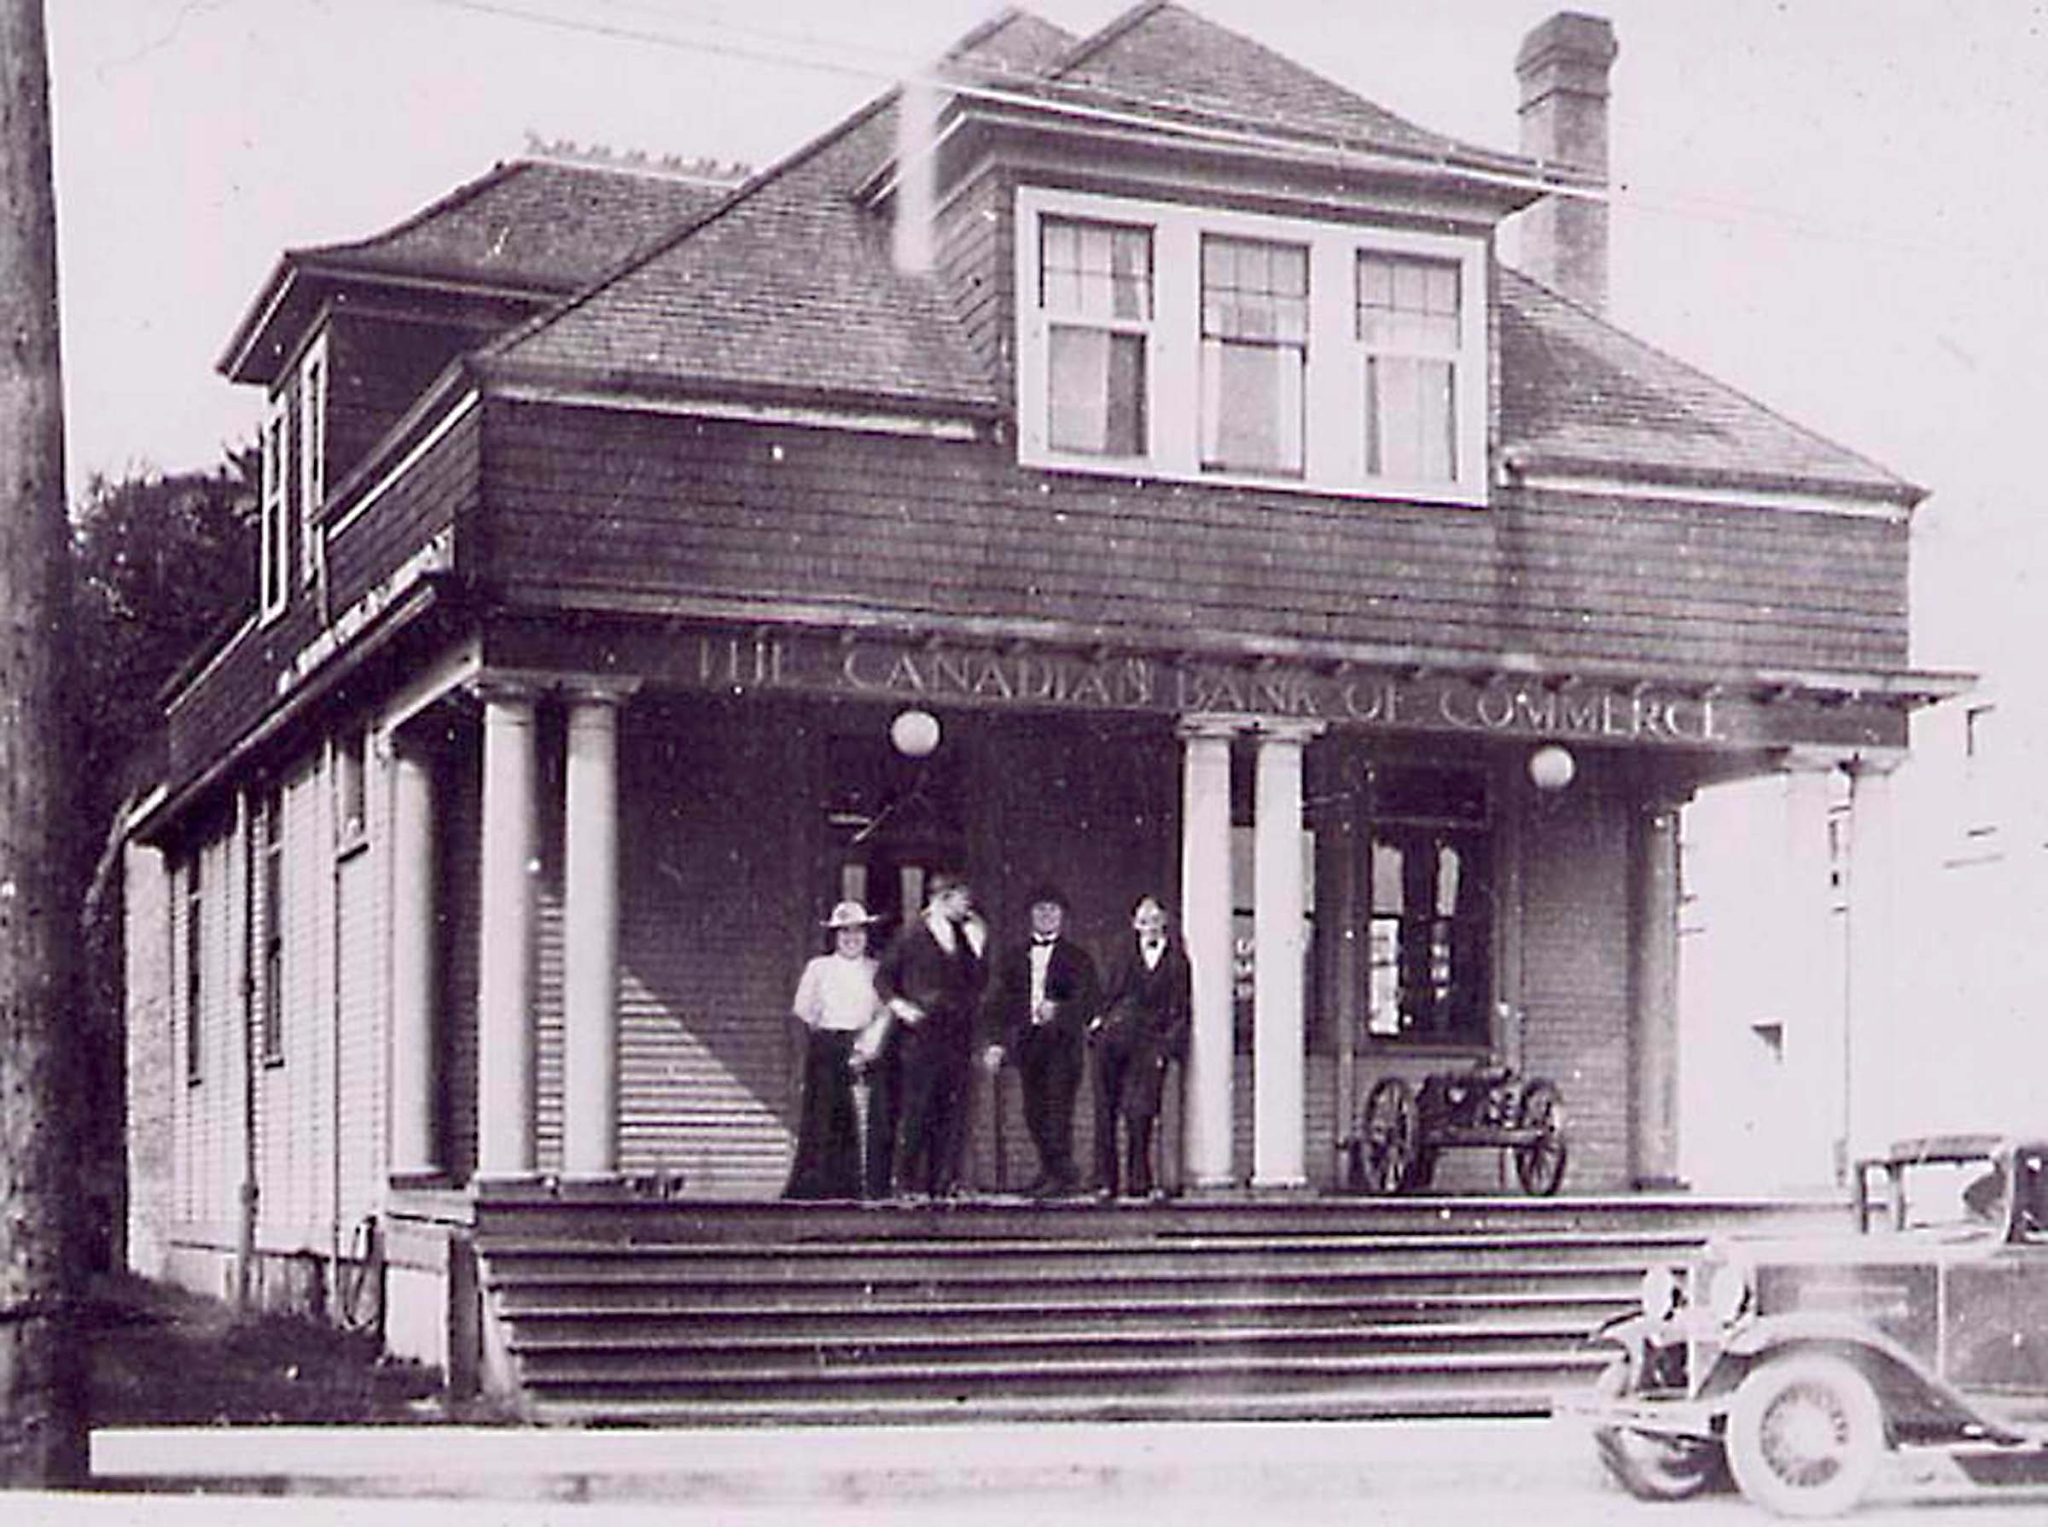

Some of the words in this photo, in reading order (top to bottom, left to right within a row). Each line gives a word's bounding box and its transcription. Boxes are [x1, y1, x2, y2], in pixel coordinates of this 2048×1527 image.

[843, 645, 1154, 706] CANADIAN
[1175, 667, 1319, 716] BANK
[1345, 680, 1405, 723] OF
[1439, 683, 1730, 743] COMMERCE
